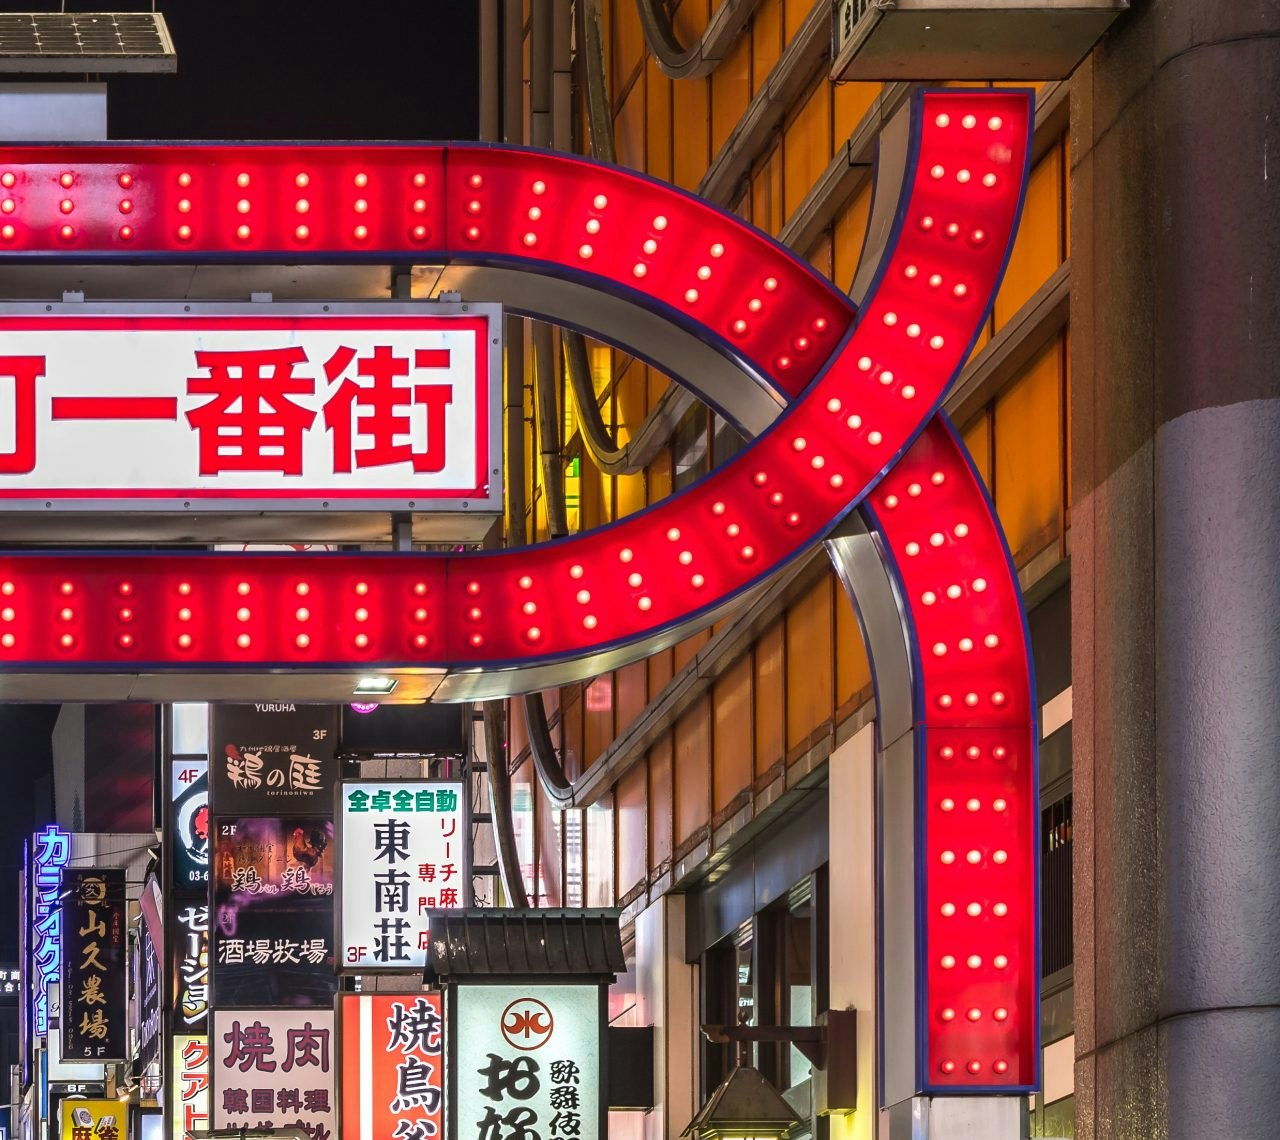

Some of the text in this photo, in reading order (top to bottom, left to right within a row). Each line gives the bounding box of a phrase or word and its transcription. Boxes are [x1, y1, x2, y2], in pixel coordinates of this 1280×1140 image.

[313, 730, 327, 740] 3F
[178, 769, 199, 784] 4F
[226, 753, 324, 790] 鶏の庭
[348, 790, 457, 812] 全卓全自動
[222, 826, 237, 836] 2F
[373, 818, 411, 962] 東南荘
[218, 939, 328, 964] 酒場牧場
[348, 946, 367, 962] 3F
[78, 909, 109, 1040] 山久農場
[223, 1021, 330, 1073] 焼肉
[223, 1088, 331, 1115] 韓国料理
